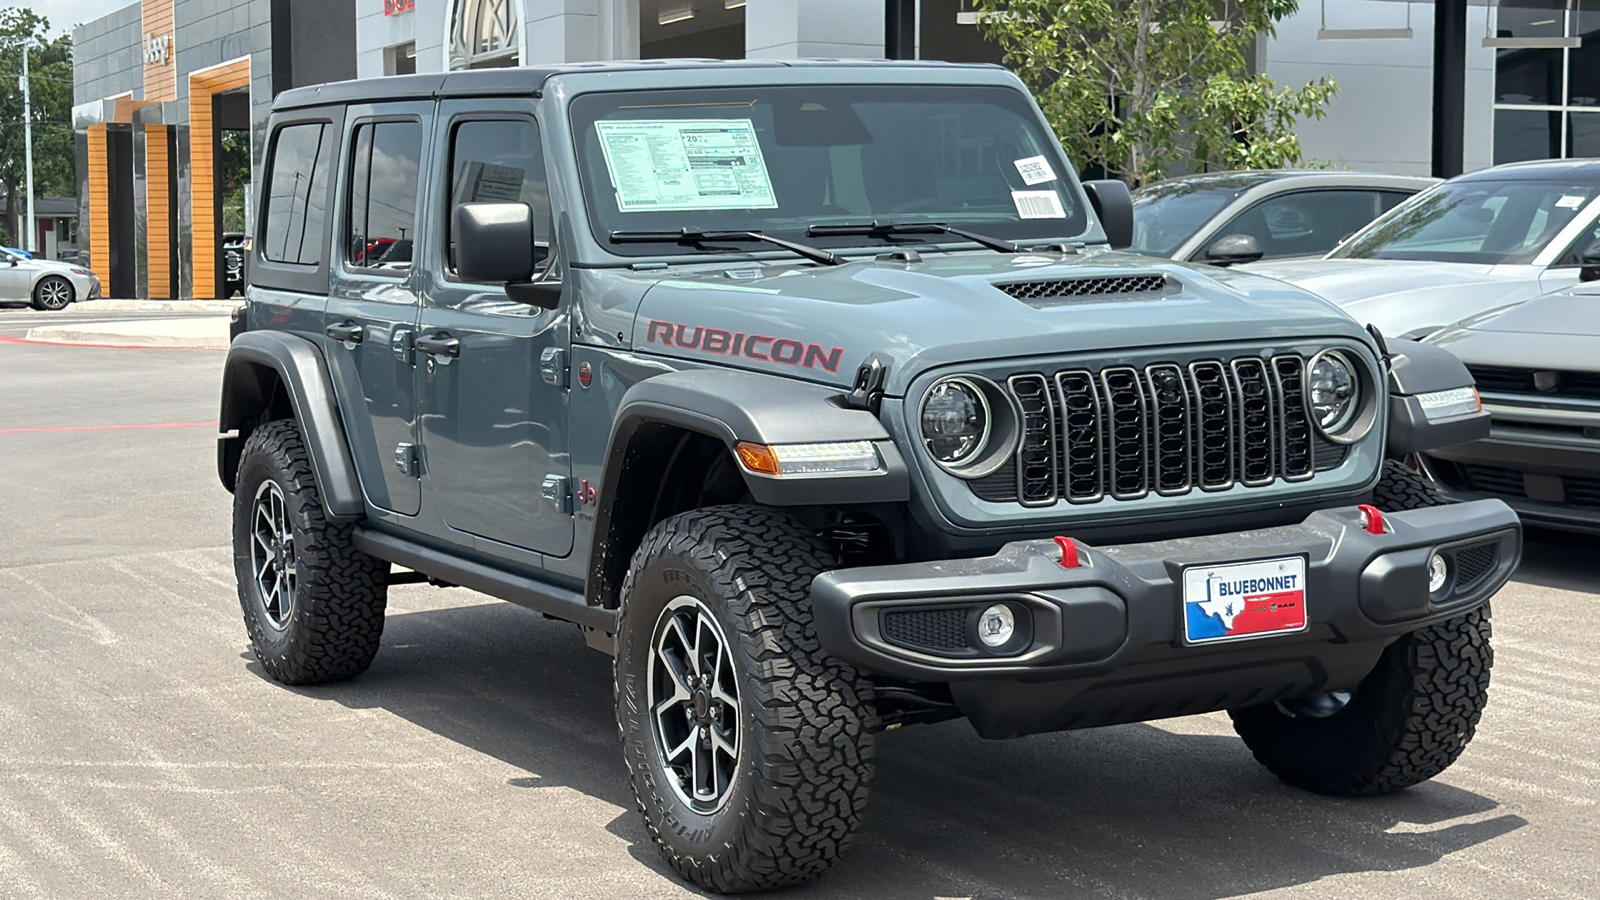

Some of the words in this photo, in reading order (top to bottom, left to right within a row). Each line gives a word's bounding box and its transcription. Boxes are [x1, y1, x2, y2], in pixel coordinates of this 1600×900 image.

[686, 135, 698, 143] 20
[646, 319, 845, 373] RUBICON
[1219, 574, 1297, 597] BLUEBONNET
